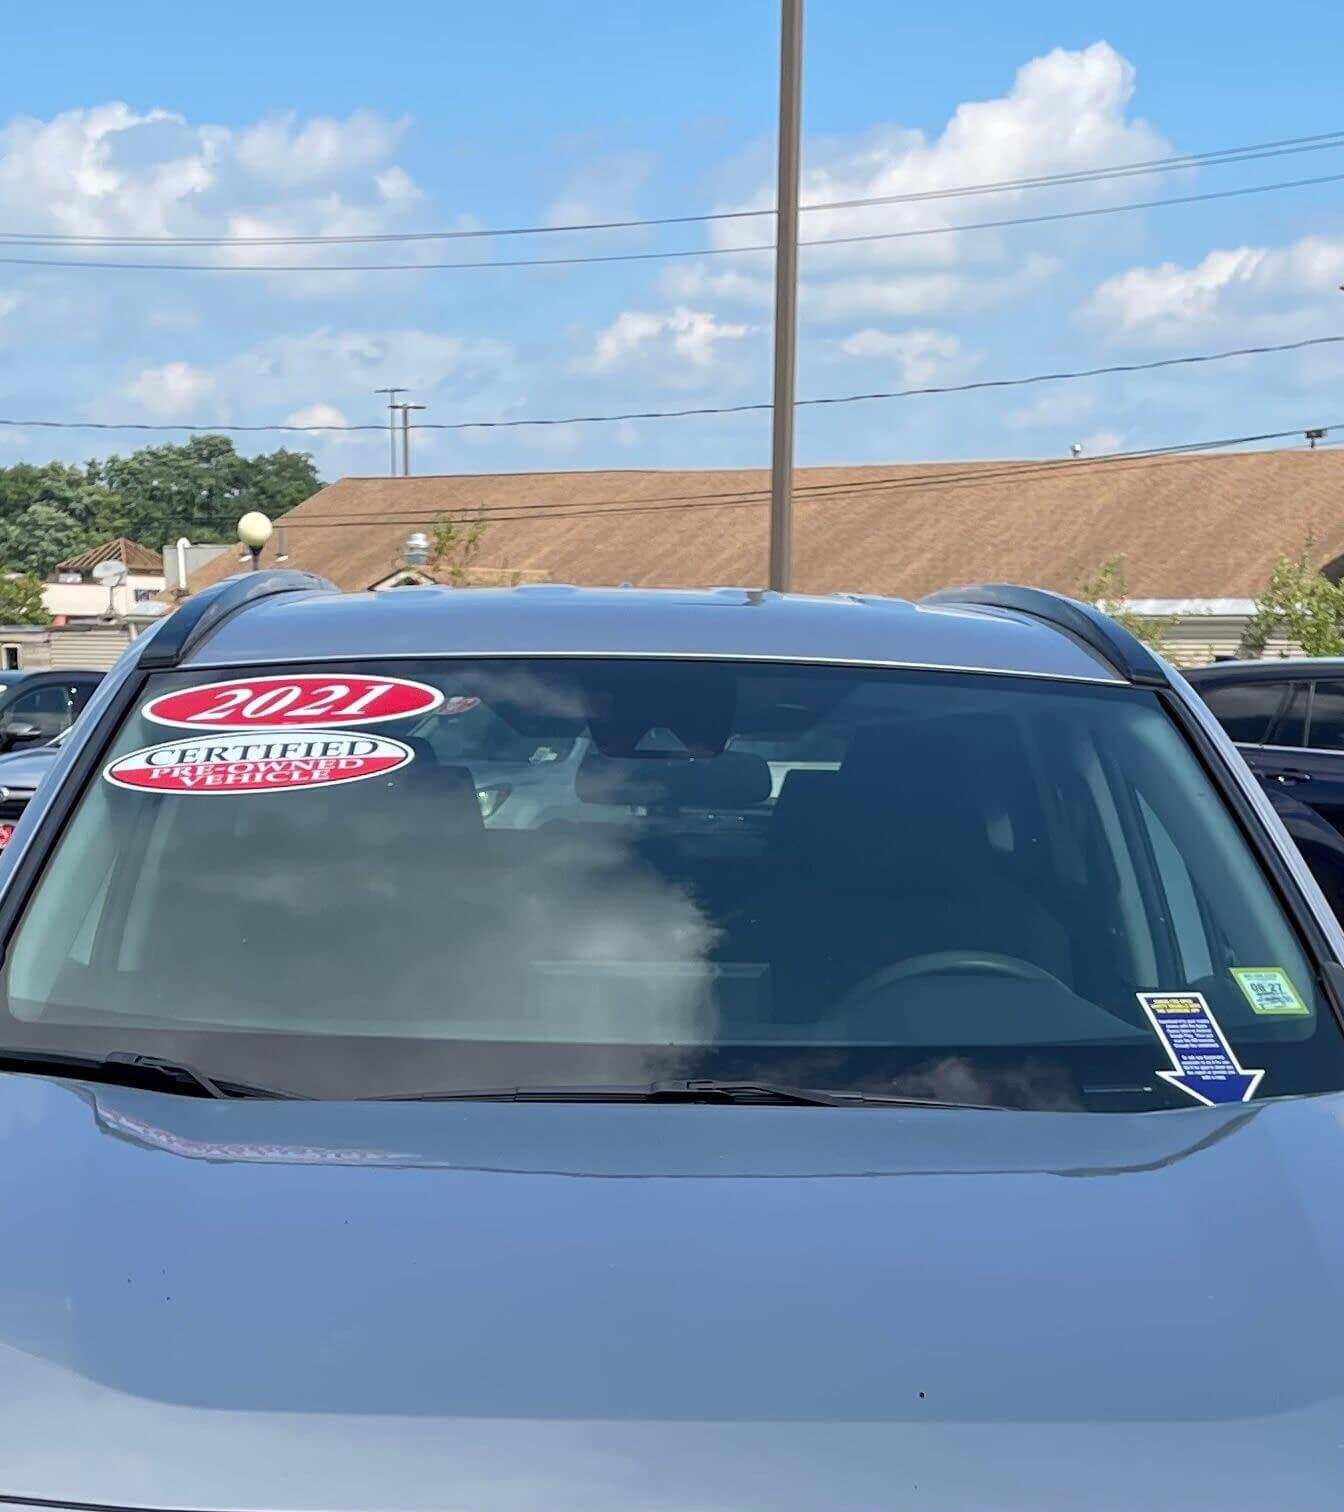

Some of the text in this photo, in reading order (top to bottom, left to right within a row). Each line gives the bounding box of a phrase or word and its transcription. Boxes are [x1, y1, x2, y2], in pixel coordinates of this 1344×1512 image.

[186, 683, 395, 721] 2021
[144, 740, 378, 766] CERTIFIED
[150, 758, 365, 780] PRE-OWNED
[179, 769, 333, 788] VEHICLE
